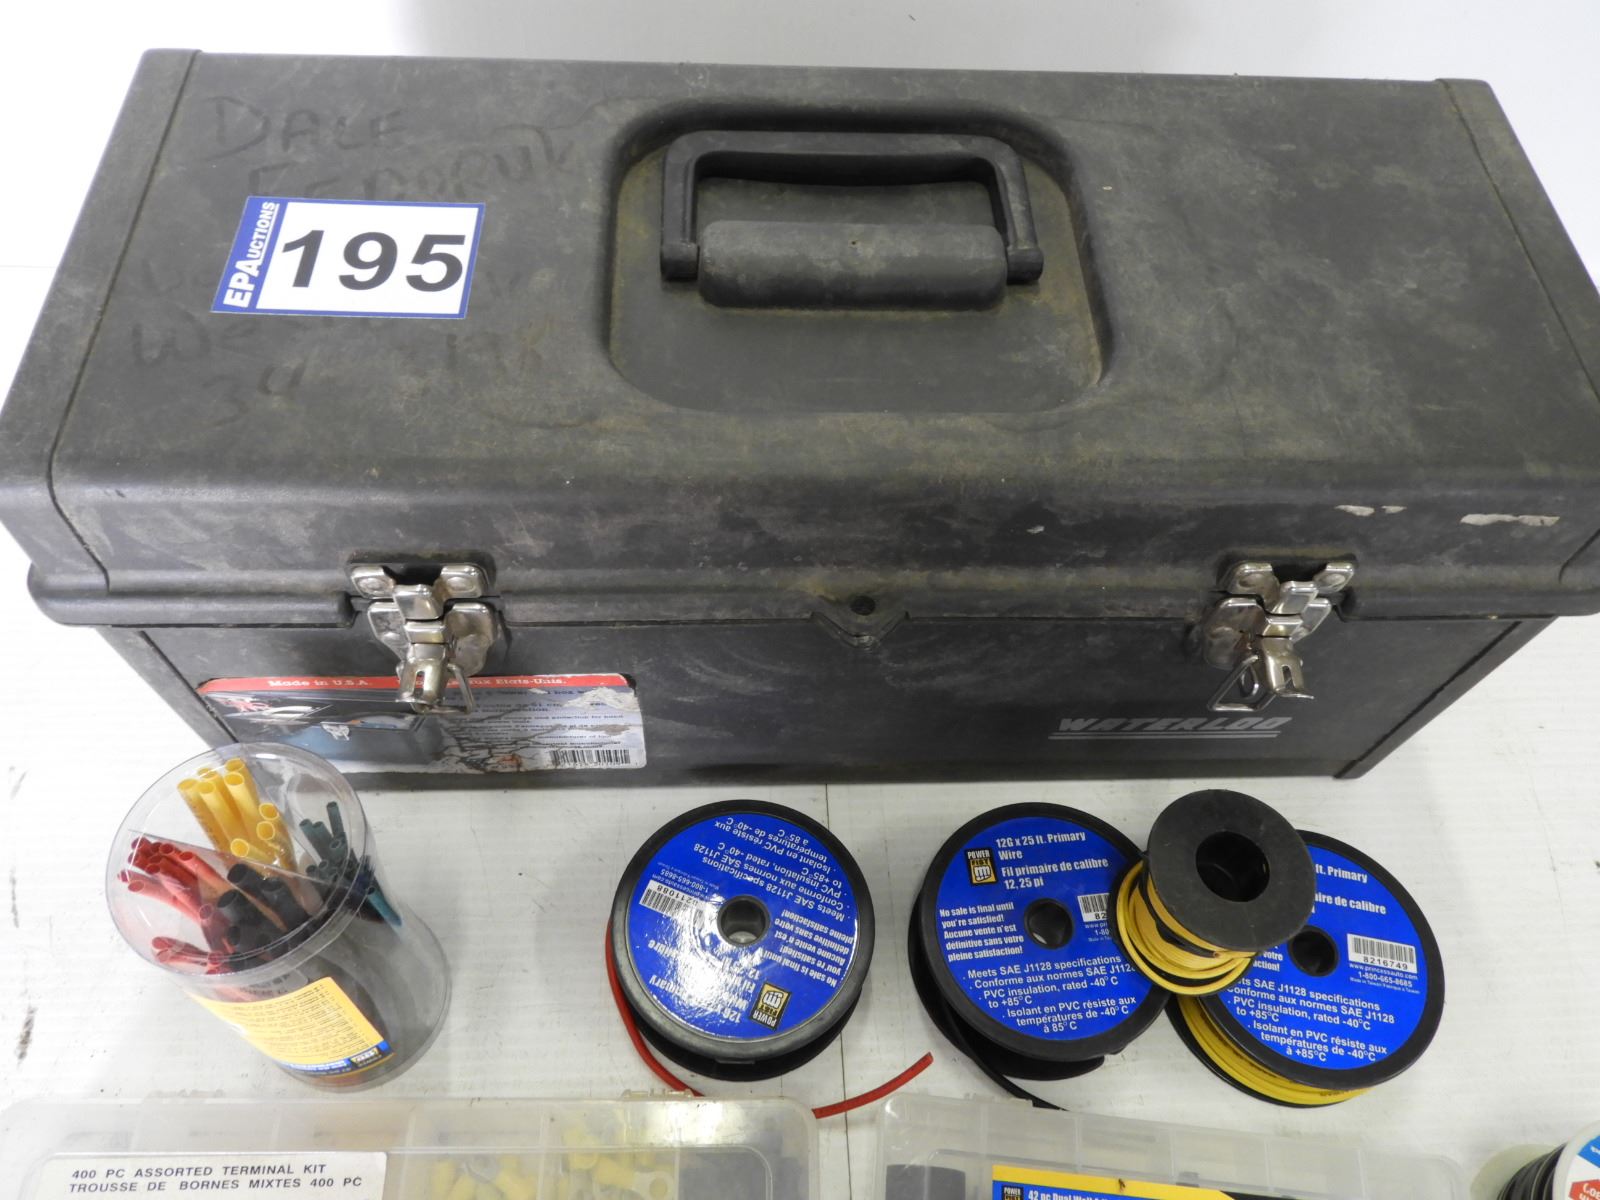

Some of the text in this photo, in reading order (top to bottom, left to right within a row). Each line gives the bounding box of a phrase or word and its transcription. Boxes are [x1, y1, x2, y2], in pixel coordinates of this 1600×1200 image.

[282, 229, 467, 292] 195
[1058, 717, 1292, 731] WATERLOO
[715, 822, 731, 831] aux
[755, 829, 766, 837] de
[996, 838, 1013, 848] 12G
[1022, 836, 1034, 845] 25
[1035, 834, 1046, 844] ft.
[1047, 832, 1085, 843] Primary
[764, 842, 784, 855] PVC
[786, 850, 798, 858] en
[967, 849, 990, 859] POWER
[998, 850, 1022, 860] Wire
[703, 857, 764, 886] specifications
[800, 856, 830, 874] Isolant
[1002, 859, 1108, 876] Fil primaire de calibre
[694, 844, 843, 910] Conforme aux normes SAE J1128
[746, 854, 841, 898] PVC insulation, rated
[1328, 866, 1367, 883] Primary
[832, 880, 842, 888] to
[1005, 877, 1044, 889] 12, 25 pi
[766, 884, 793, 899] J1128
[794, 895, 814, 909] SAE
[951, 908, 968, 916] sale
[969, 906, 976, 914] is
[977, 904, 995, 912] final
[996, 902, 1014, 910] until
[1334, 896, 1347, 906] de
[1349, 900, 1386, 914] calibre
[818, 904, 844, 922] Meets
[942, 914, 1004, 928] you're satisfied!
[775, 919, 794, 931] votre
[781, 910, 855, 944] pleine satisfaction!
[794, 927, 813, 939] sans
[944, 924, 1016, 939] Aucune vente n'est
[774, 931, 845, 966] Aucune vente n'est
[984, 938, 1002, 946] sans
[1004, 936, 1024, 944] votre
[780, 945, 841, 976] you're satisfied!
[948, 946, 1022, 962] pleine satisfaction!
[763, 950, 837, 987] No sale is final until
[968, 956, 1121, 978] Meets SAE J1128 specifications
[1362, 956, 1408, 969] 8216749
[975, 978, 1023, 988] Conforme
[1047, 971, 1083, 980] normes
[1086, 966, 1107, 976] SAE
[1358, 971, 1412, 988] 1-800-665-8685
[984, 980, 1087, 999] PVC insulation, rated
[1254, 980, 1274, 990] SAE
[1278, 985, 1306, 996] J1128
[1310, 992, 1380, 1010] specifications
[1007, 1006, 1042, 1017] Isolant
[1059, 1001, 1080, 1011] PVC
[1083, 998, 1116, 1008] résiste
[1234, 996, 1254, 1008] PVC
[1257, 1002, 1310, 1020] insulation,
[1314, 1014, 1339, 1024] rated
[1237, 1006, 1246, 1015] to
[1279, 996, 1296, 1004] aux
[1300, 1000, 1338, 1012] normes
[1341, 1006, 1362, 1017] SAE
[1366, 1012, 1394, 1023] J1128
[751, 1008, 777, 1027] POWER
[1016, 1010, 1098, 1026] températures de
[1254, 1020, 1288, 1035] Isolant
[1306, 1031, 1327, 1042] PVC
[1331, 1037, 1365, 1050] résiste
[1369, 1045, 1386, 1054] aux
[1261, 1032, 1328, 1052] températures
[1332, 1046, 1344, 1055] de
[1285, 1046, 1292, 1054] à
[72, 1164, 326, 1179] 400 PC ASSORTED TERMINAL KIT
[69, 1177, 362, 1193] TROUSSE DE BORNES MIXTES 400 PC
[1003, 1186, 1021, 1195] POWER
[1028, 1190, 1039, 1200] 42
